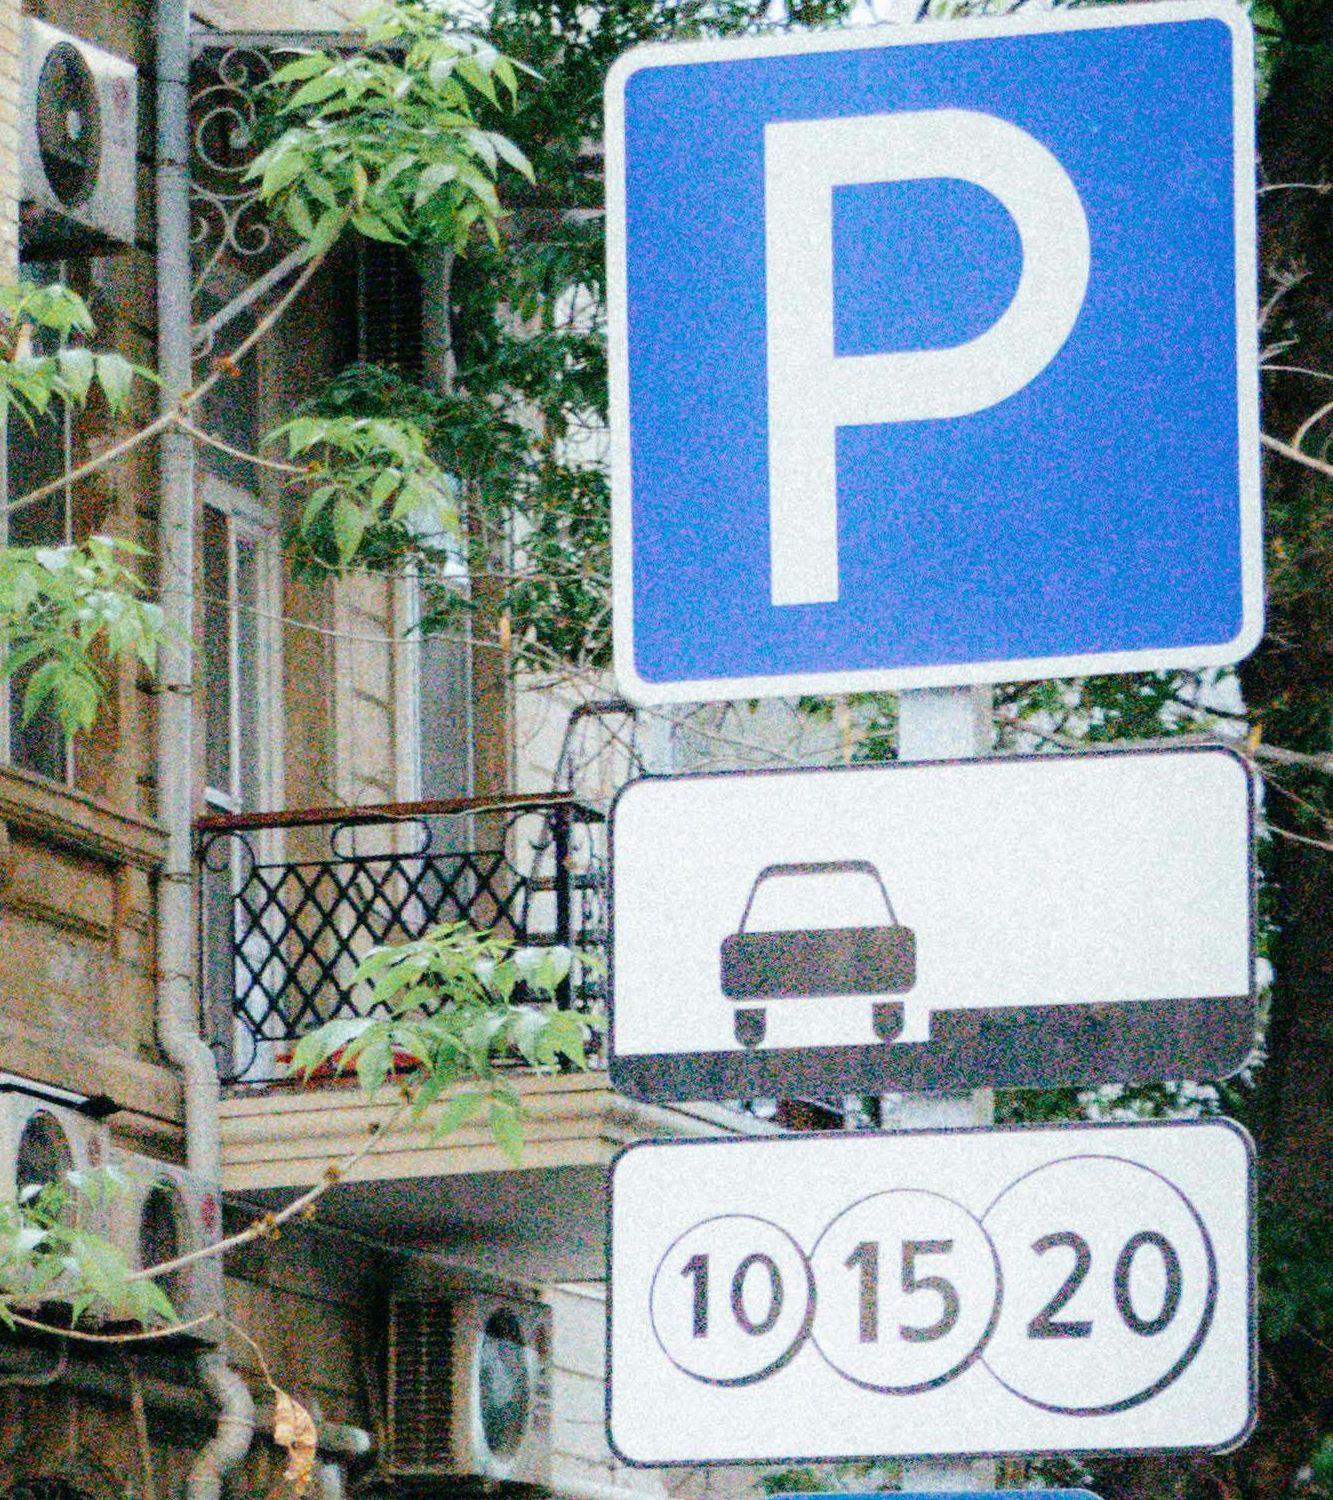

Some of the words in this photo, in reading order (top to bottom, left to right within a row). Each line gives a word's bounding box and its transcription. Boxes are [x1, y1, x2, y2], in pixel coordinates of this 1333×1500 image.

[765, 108, 1091, 605] P
[680, 1252, 784, 1338] 10
[843, 1238, 960, 1343] 15
[1027, 1230, 1183, 1339] 20
